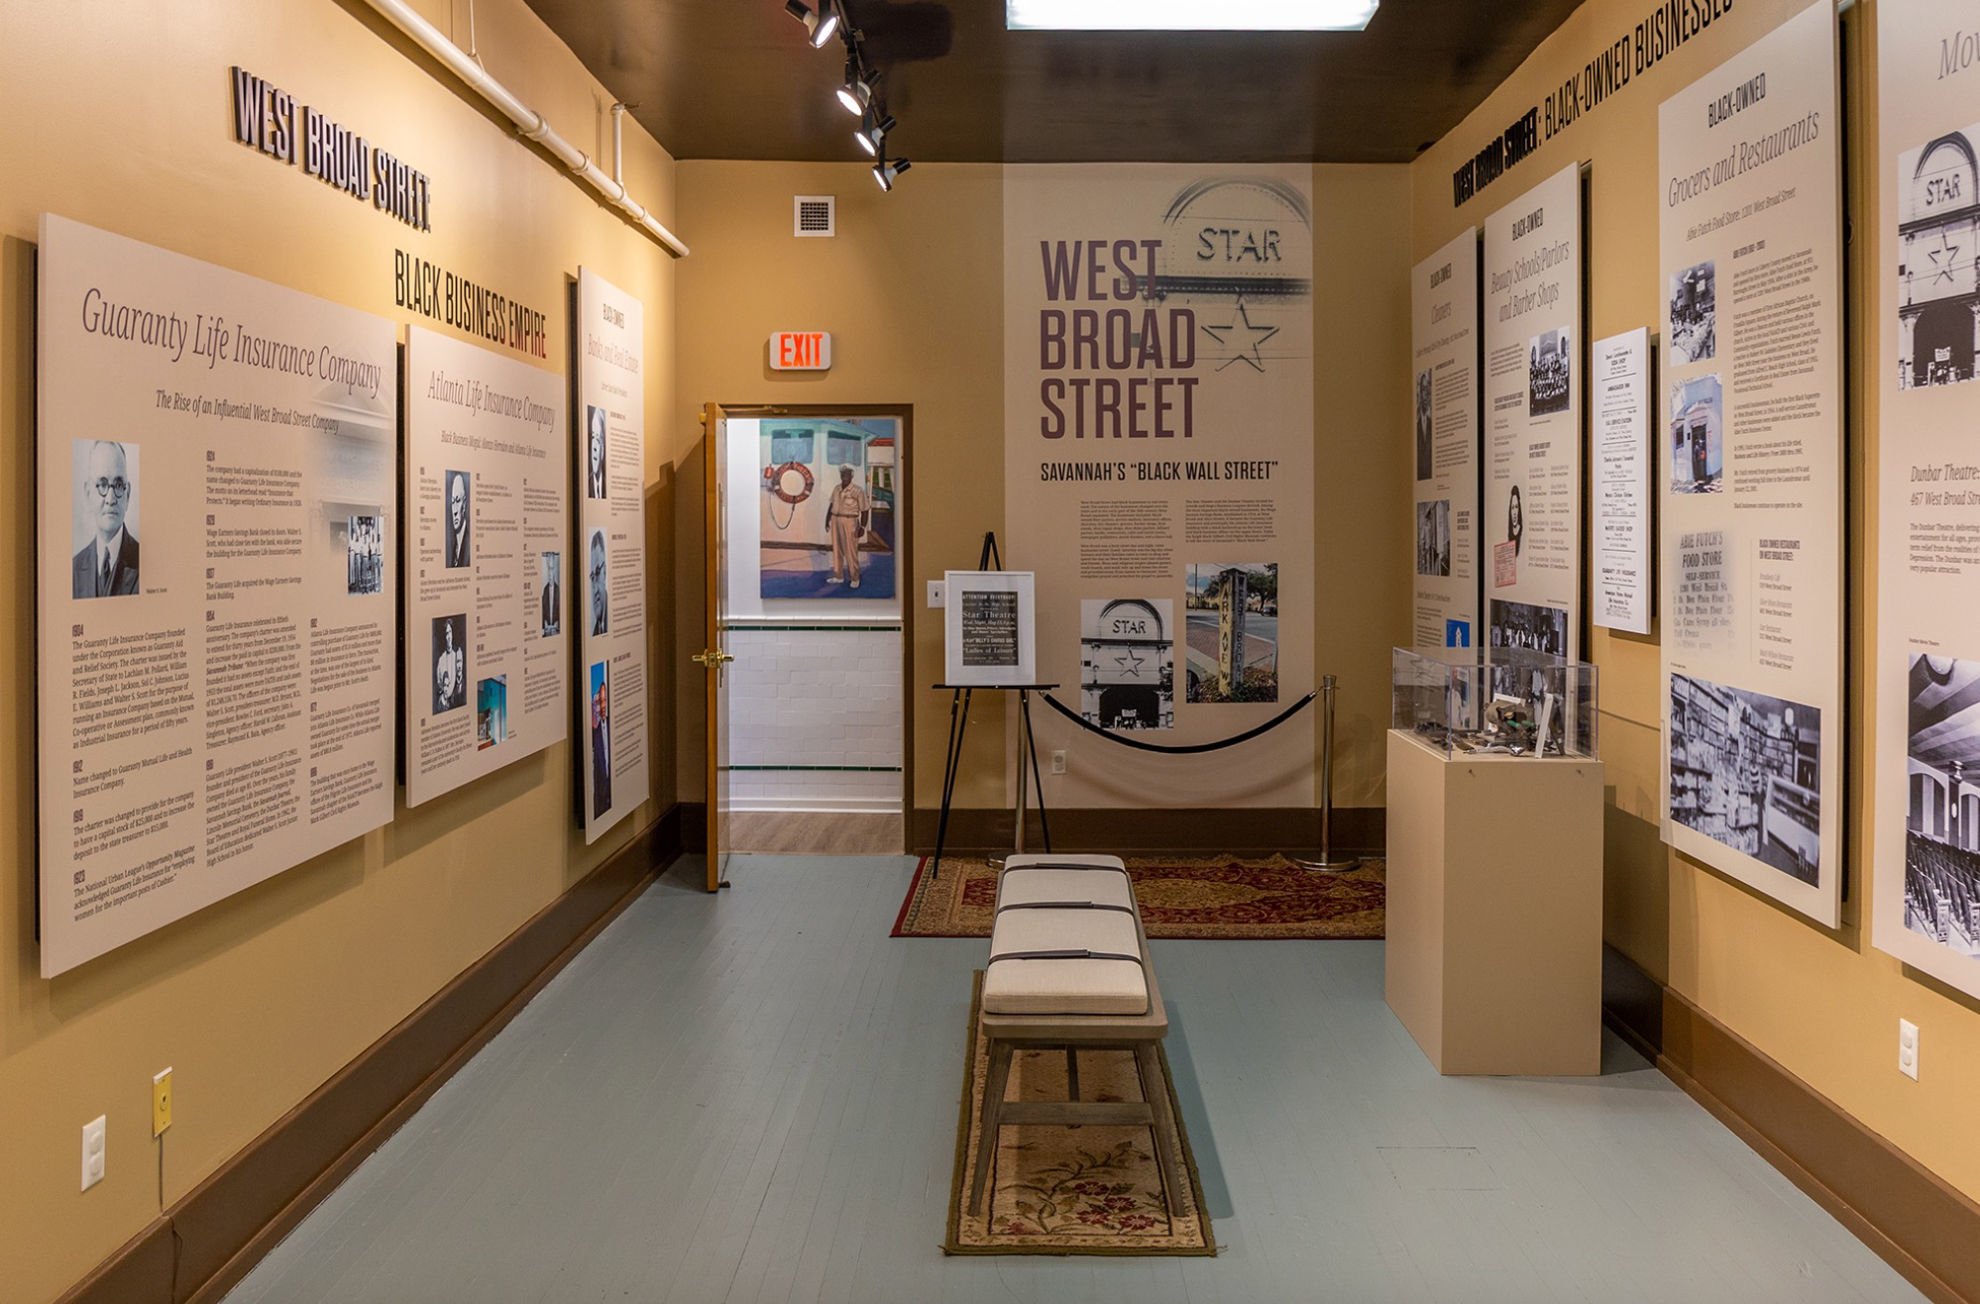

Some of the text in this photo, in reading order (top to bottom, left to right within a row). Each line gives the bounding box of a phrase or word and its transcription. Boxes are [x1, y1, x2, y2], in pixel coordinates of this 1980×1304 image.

[1454, 159, 1474, 208] WEST
[1476, 136, 1503, 192] BROAD
[1545, 35, 1629, 141] BLACK-OWNED
[1635, 0, 1732, 76] BUSINES
[1709, 72, 1765, 128] BLACK-OWNED
[231, 66, 431, 233] WEST BROAD STREET
[1669, 110, 1819, 207] Grocers and Restaurants
[1754, 199, 1764, 213] West
[1766, 192, 1780, 208] Broad
[1782, 187, 1796, 203] Street
[1926, 174, 1960, 206] STAR
[1513, 208, 1543, 241] BLACK-OWNED
[1197, 228, 1282, 263] STAR
[1041, 240, 1162, 301] WEST
[1491, 270, 1513, 294] Beauty
[395, 248, 546, 359] BLACK BUSINESS EMPIRE
[1500, 282, 1559, 322] and Barber Shops
[82, 288, 382, 399] Guaranty Life Insurance Company
[780, 333, 823, 367] EXIT
[1041, 309, 1196, 370] BROAD
[156, 390, 339, 435] The Rise of an Influential West Broad Street Company
[428, 371, 555, 433] Atlanta Life Insurance Company
[1041, 378, 1198, 439] STREET
[1041, 462, 1126, 481] SAVANNAH'S
[1186, 462, 1220, 480] WALL
[1911, 464, 1942, 482] Dunbar
[1926, 492, 1942, 505] West
[1944, 490, 1966, 505] Broad
[1682, 551, 1722, 568] FOOD STORE
[984, 611, 1016, 619] Theatre
[1112, 620, 1146, 633] STAR
[72, 628, 185, 649] The Guaranty Life Insurance Company founded
[72, 652, 88, 662] under
[90, 651, 98, 659] the
[99, 647, 128, 659] Corporation
[130, 644, 146, 654] known
[154, 641, 174, 651] Guaranty
[72, 666, 82, 674] and
[84, 663, 99, 673] Relief
[120, 659, 128, 667] The
[130, 656, 147, 666] charter
[148, 654, 156, 663] was
[158, 652, 173, 661] issued
[173, 651, 180, 659] by
[73, 747, 192, 786] Name changed to Guaranty Mutual Life and Health
[73, 784, 99, 799] Insurance
[74, 886, 83, 897] The
[85, 878, 107, 893] National
[108, 871, 124, 884] Urban
[146, 853, 172, 870] Opportunity
[174, 845, 194, 859] Magazine
[74, 907, 93, 922] women
[103, 899, 112, 909] the
[113, 889, 137, 906] important
[138, 884, 150, 896] posts
[151, 881, 157, 889] of
